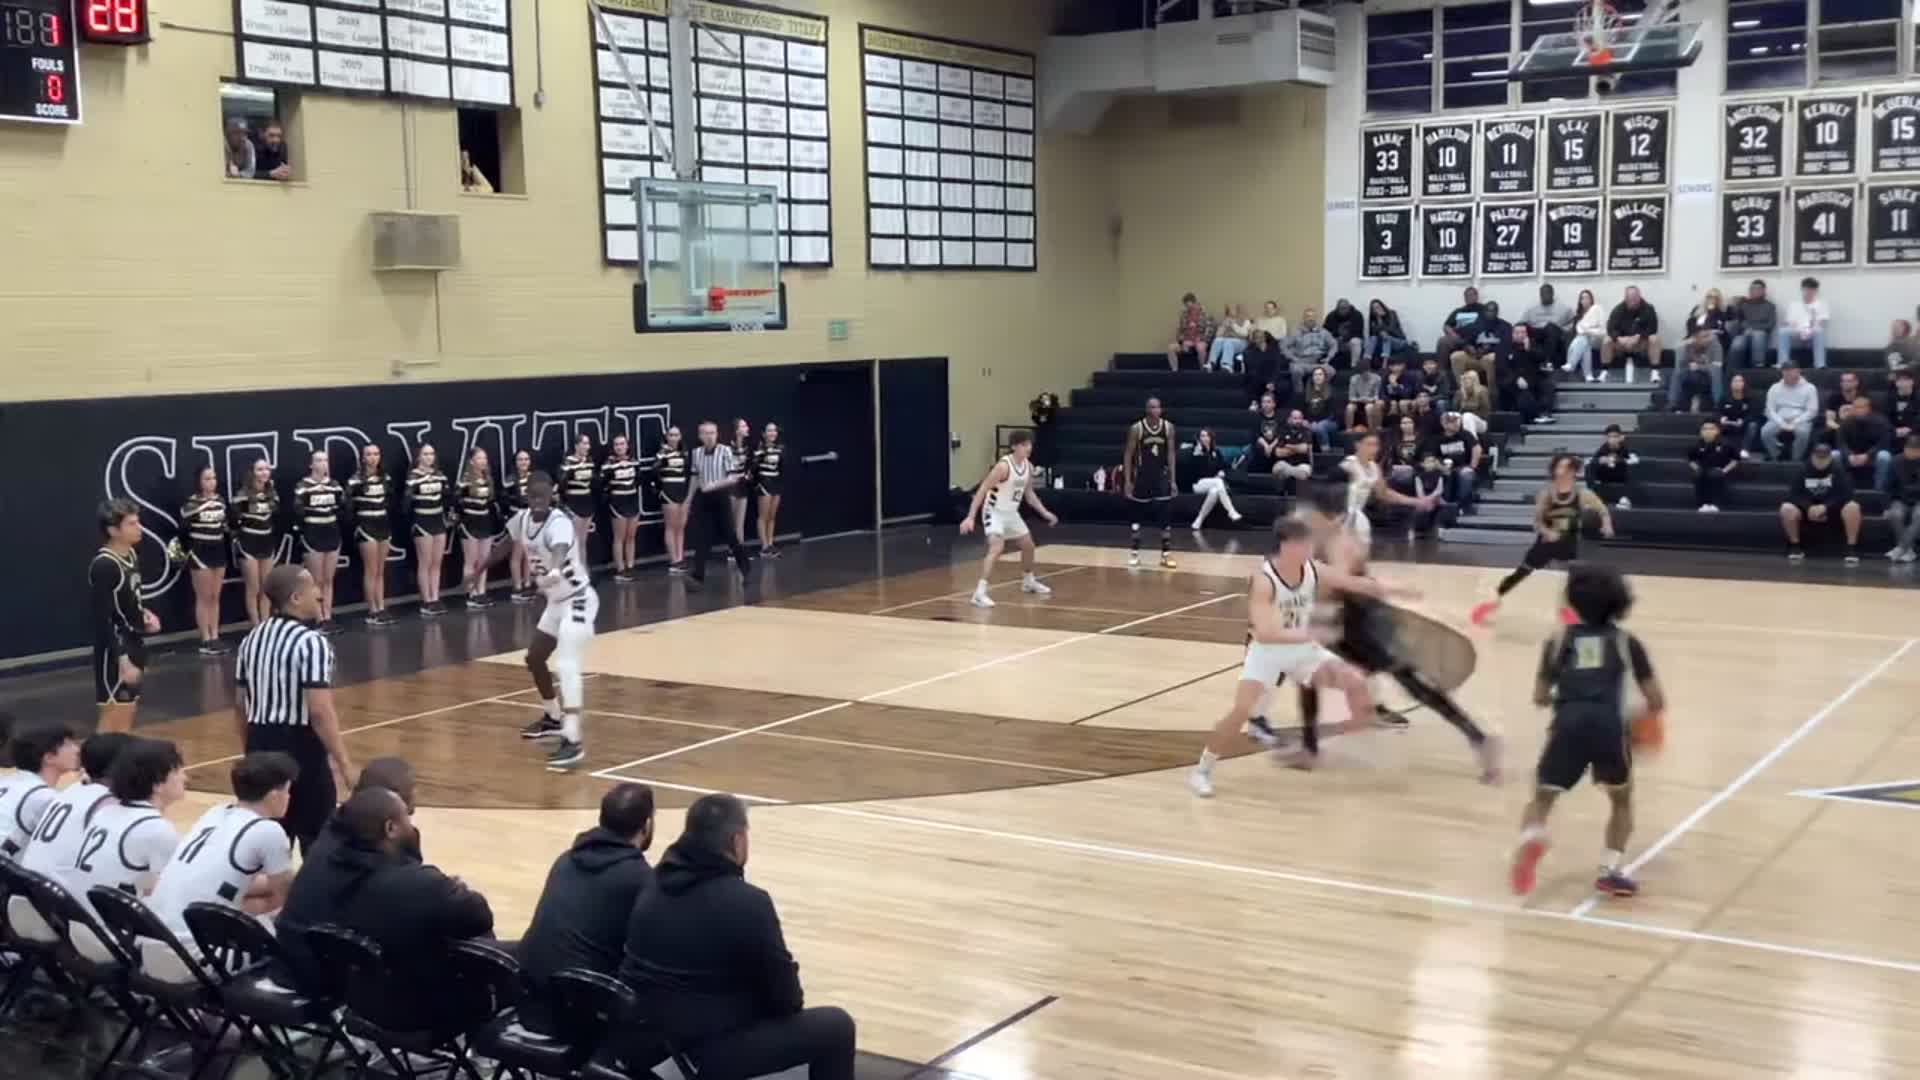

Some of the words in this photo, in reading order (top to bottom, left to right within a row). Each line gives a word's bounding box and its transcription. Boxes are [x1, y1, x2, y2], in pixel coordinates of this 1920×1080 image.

[31, 57, 65, 71] FOULS
[47, 73, 63, 102] 0
[34, 103, 69, 117] SCORE
[1740, 126, 1769, 149] 32
[1816, 121, 1839, 145] 10
[1891, 116, 1916, 141] 15
[1502, 143, 1518, 165] 11
[1563, 138, 1584, 161] 15
[1629, 133, 1651, 157] 12
[1376, 150, 1399, 172] 33
[1438, 146, 1457, 168] 10
[1629, 219, 1644, 242] 2
[1736, 214, 1765, 238] 33
[1812, 211, 1836, 236] 41
[1891, 208, 1909, 232] 11
[1380, 229, 1393, 250] 3
[1439, 227, 1457, 249] 10
[1496, 224, 1521, 246] 27
[1563, 222, 1583, 244] 19
[33, 803, 73, 843] 10
[75, 825, 109, 873] 12
[178, 826, 216, 865] 11
